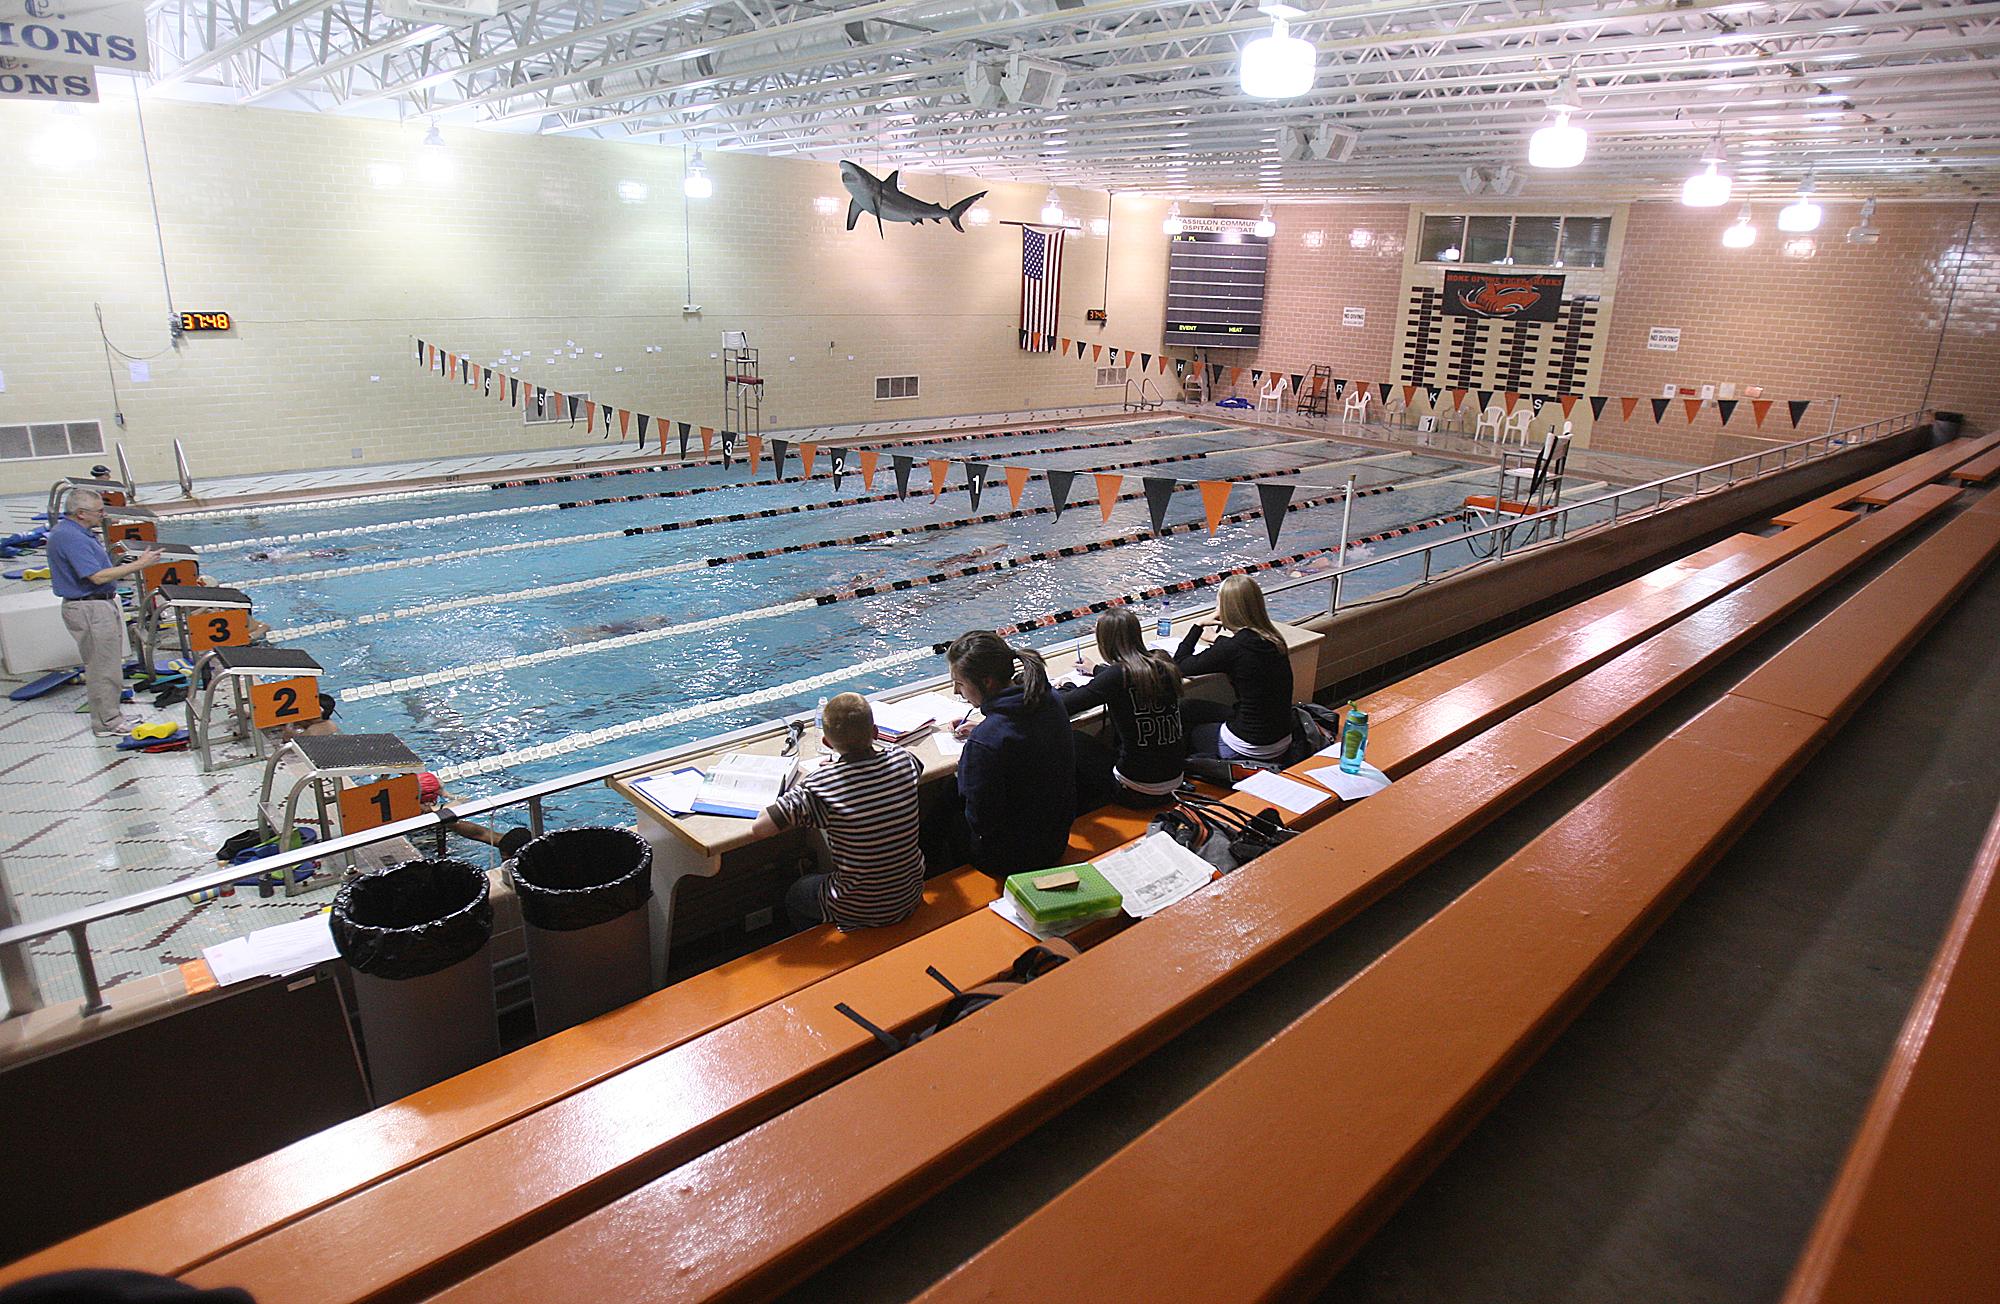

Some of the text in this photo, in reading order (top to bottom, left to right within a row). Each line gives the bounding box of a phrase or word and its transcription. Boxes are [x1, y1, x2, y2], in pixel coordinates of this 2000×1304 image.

[182, 314, 229, 329] 37:48
[1111, 352, 1116, 360] S
[1253, 374, 1259, 382] A
[1336, 384, 1343, 393] R
[1429, 392, 1438, 402] K
[1534, 399, 1542, 410] S
[538, 393, 544, 406] 5
[725, 440, 733, 456] 3
[835, 458, 843, 476] 2
[973, 475, 980, 494] 1
[161, 567, 181, 585] 4
[208, 618, 231, 643] 3
[272, 687, 299, 718] 2
[370, 788, 392, 823] 1
